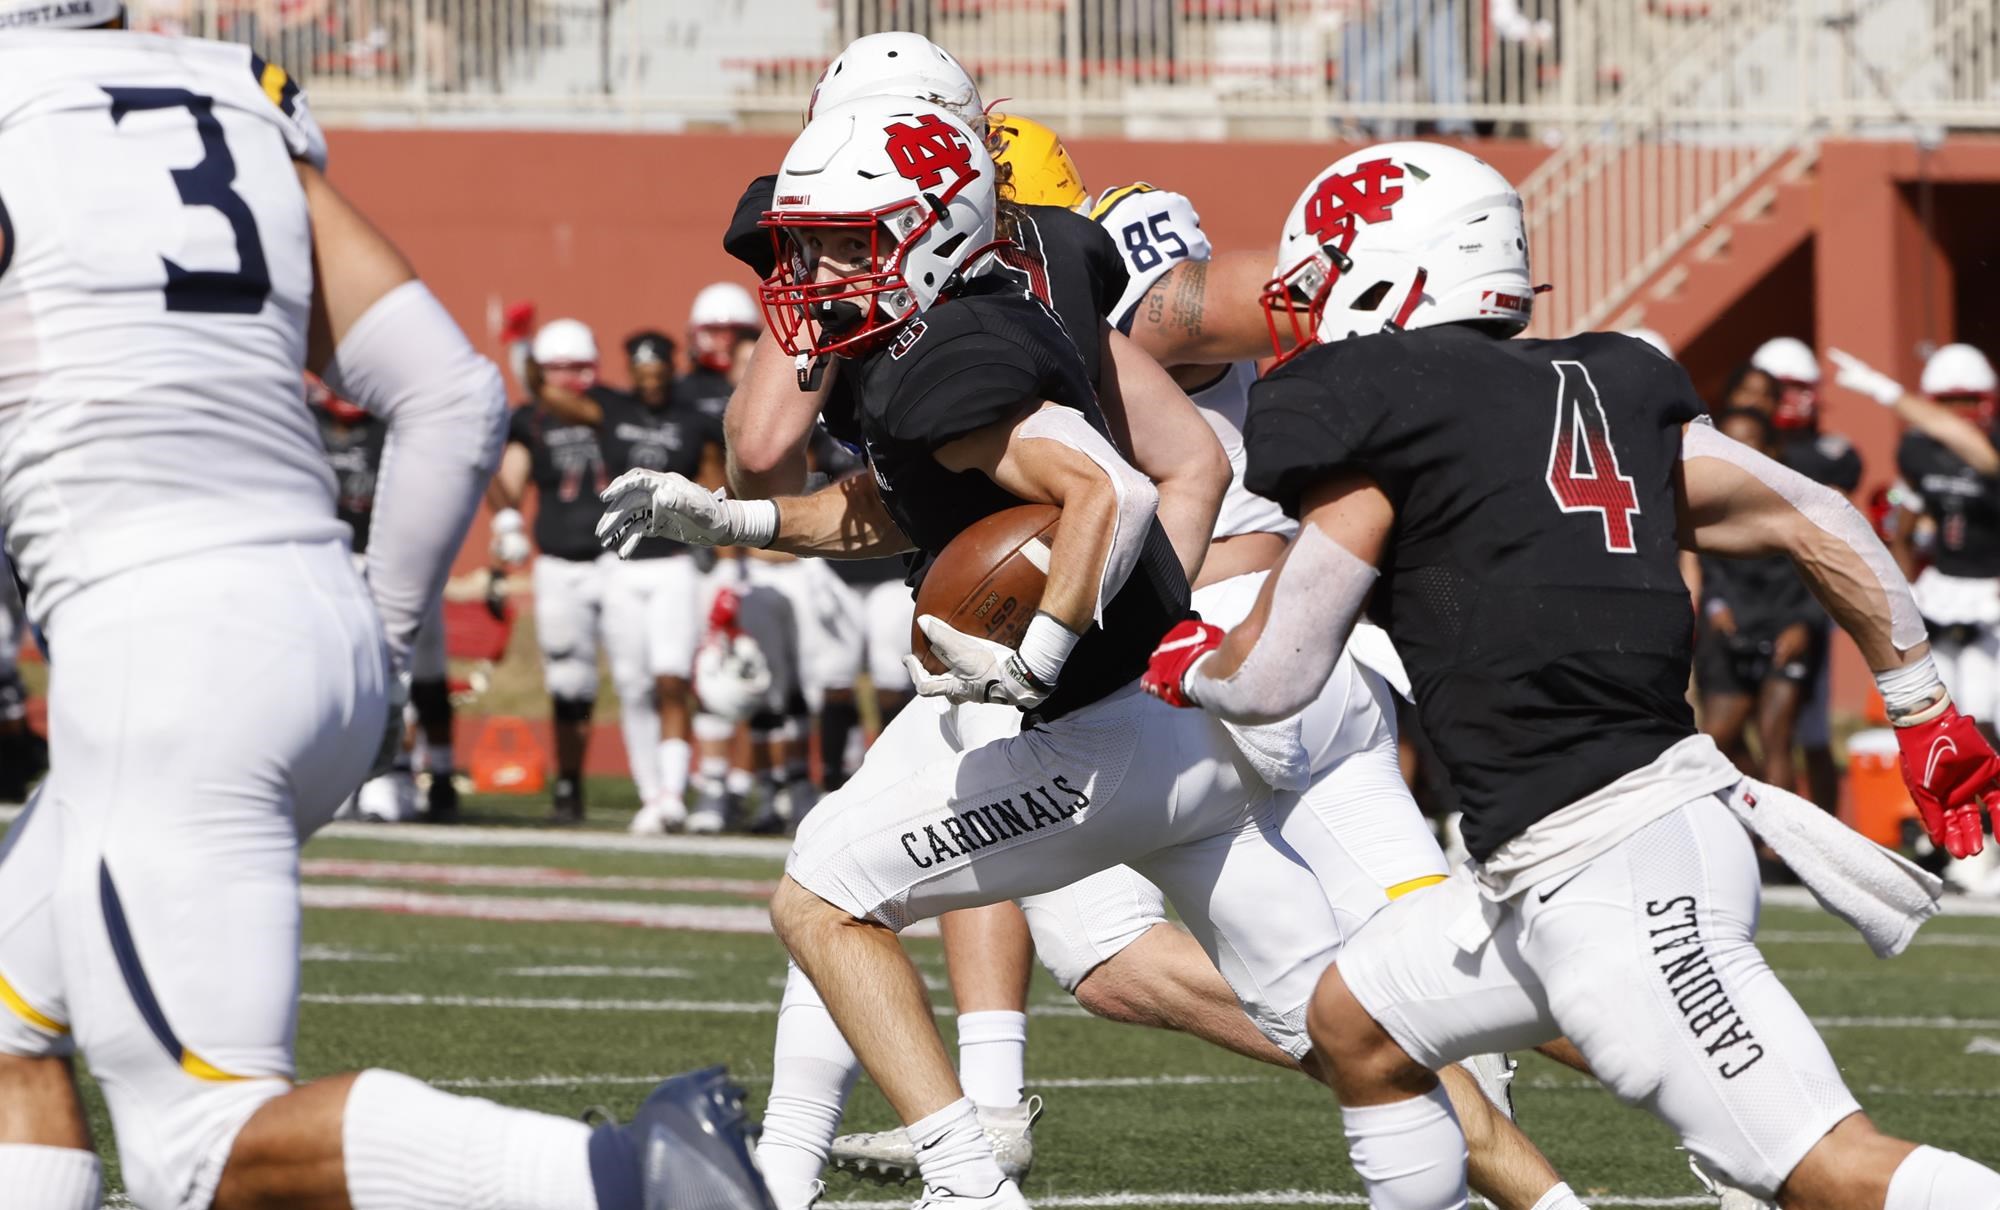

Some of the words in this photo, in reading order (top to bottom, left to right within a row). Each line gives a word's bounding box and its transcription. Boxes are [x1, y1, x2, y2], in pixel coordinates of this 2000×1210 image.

[1122, 211, 1189, 273] 85
[1545, 361, 1641, 553] 4
[975, 592, 999, 618] NCAA
[901, 775, 1090, 869] CARDINALS
[1646, 896, 1764, 1079] CARDINALS
